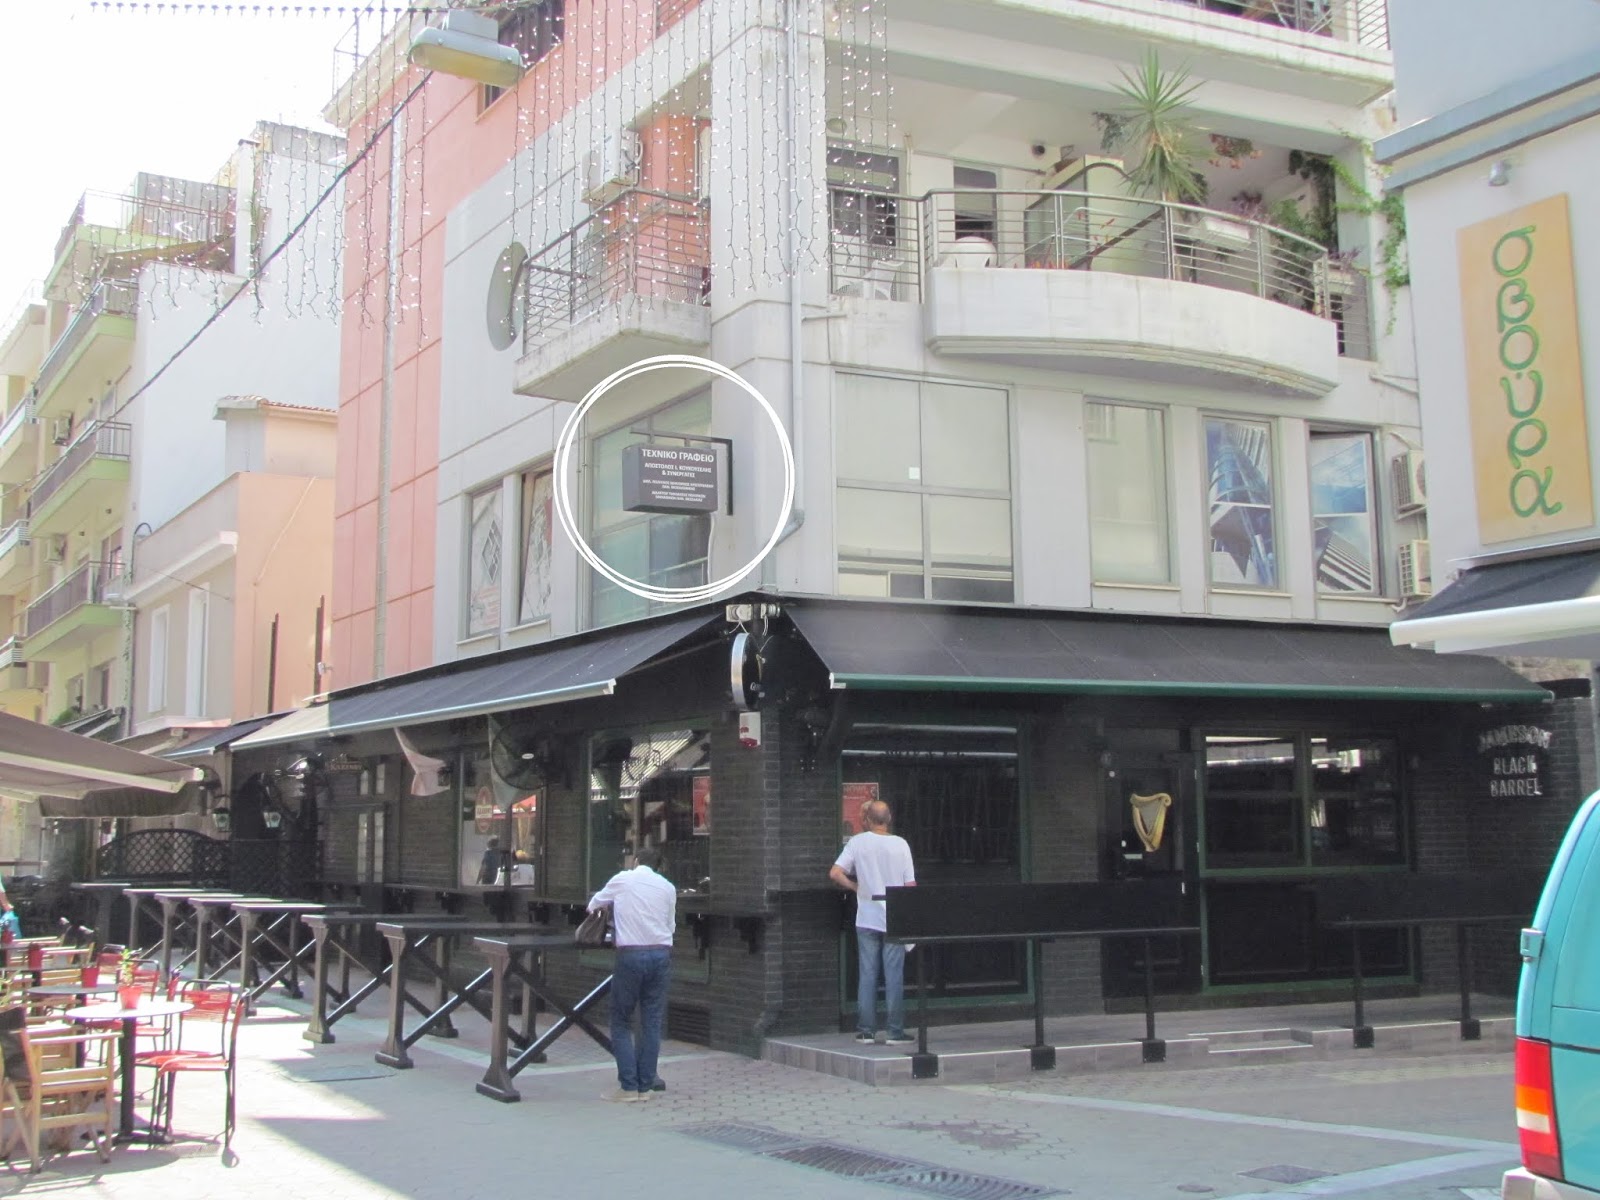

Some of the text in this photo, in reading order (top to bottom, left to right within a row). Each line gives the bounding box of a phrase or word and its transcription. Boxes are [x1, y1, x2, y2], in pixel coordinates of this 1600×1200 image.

[641, 449, 714, 463] ΤΕΧΝΙΚΟ ΓΡΑΦΕΙΟ
[1478, 725, 1552, 753] JAMESON
[1493, 755, 1537, 775] BLACK
[1490, 778, 1542, 797] BARREL
